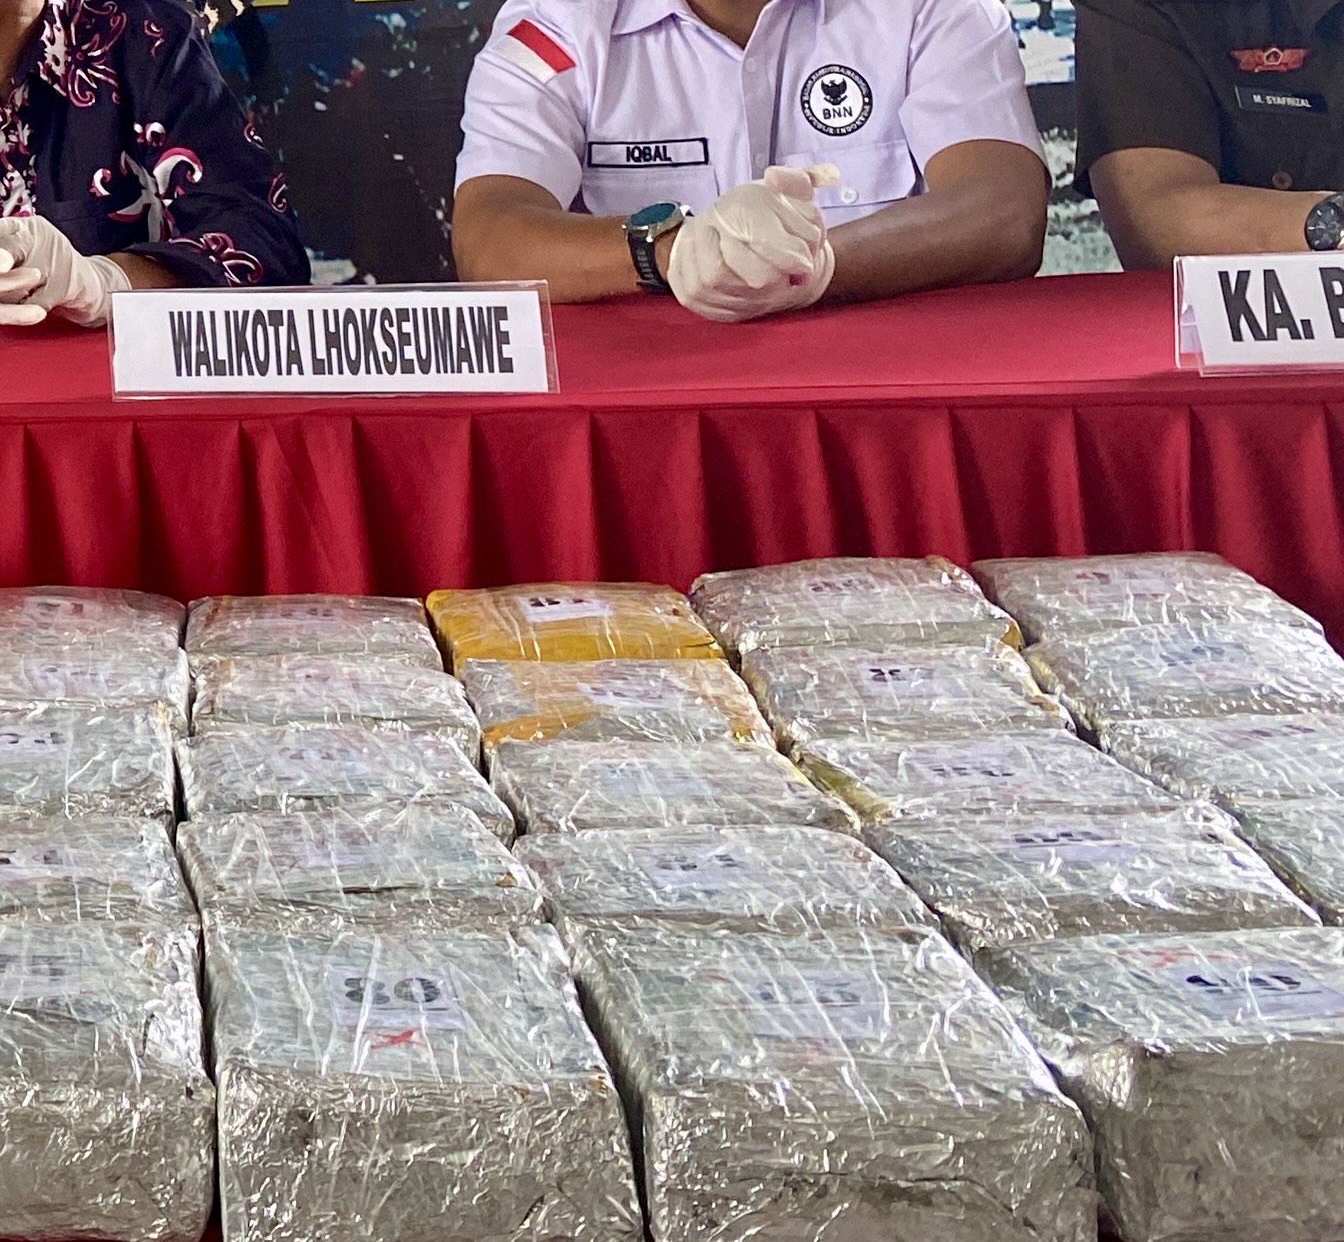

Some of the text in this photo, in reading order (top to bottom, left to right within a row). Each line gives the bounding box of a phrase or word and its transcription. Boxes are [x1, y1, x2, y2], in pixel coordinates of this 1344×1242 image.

[822, 106, 853, 121] BNN
[626, 145, 672, 163] IQBAL
[1218, 269, 1315, 342] KA.
[168, 305, 515, 378] WALIKOTA LHOKSEUMAWE
[344, 976, 441, 1005] 80
